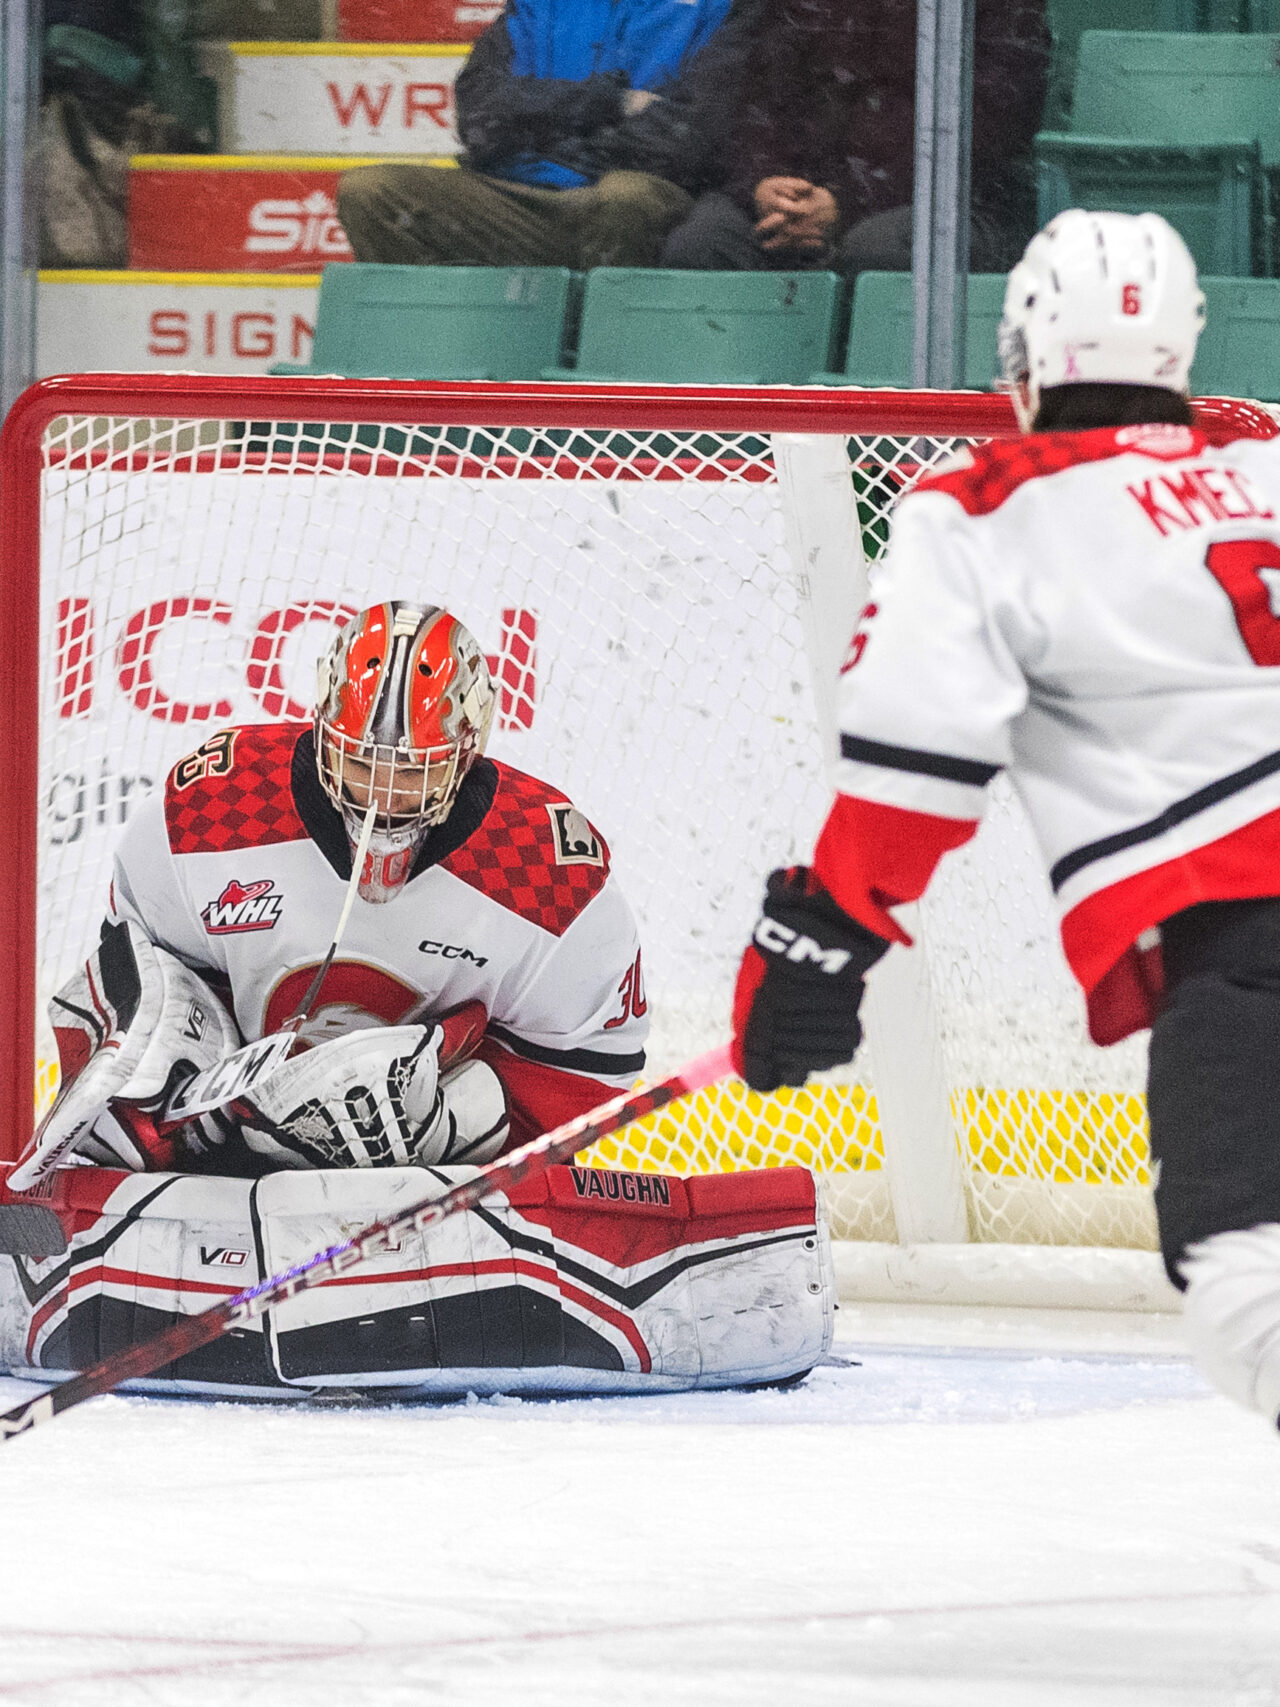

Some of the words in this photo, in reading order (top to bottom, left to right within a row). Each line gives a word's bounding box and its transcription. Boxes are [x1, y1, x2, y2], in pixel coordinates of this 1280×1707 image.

[1121, 282, 1141, 316] 6
[208, 894, 284, 928] WHL
[418, 939, 489, 968] CCM
[570, 1167, 671, 1207] VAUGHN
